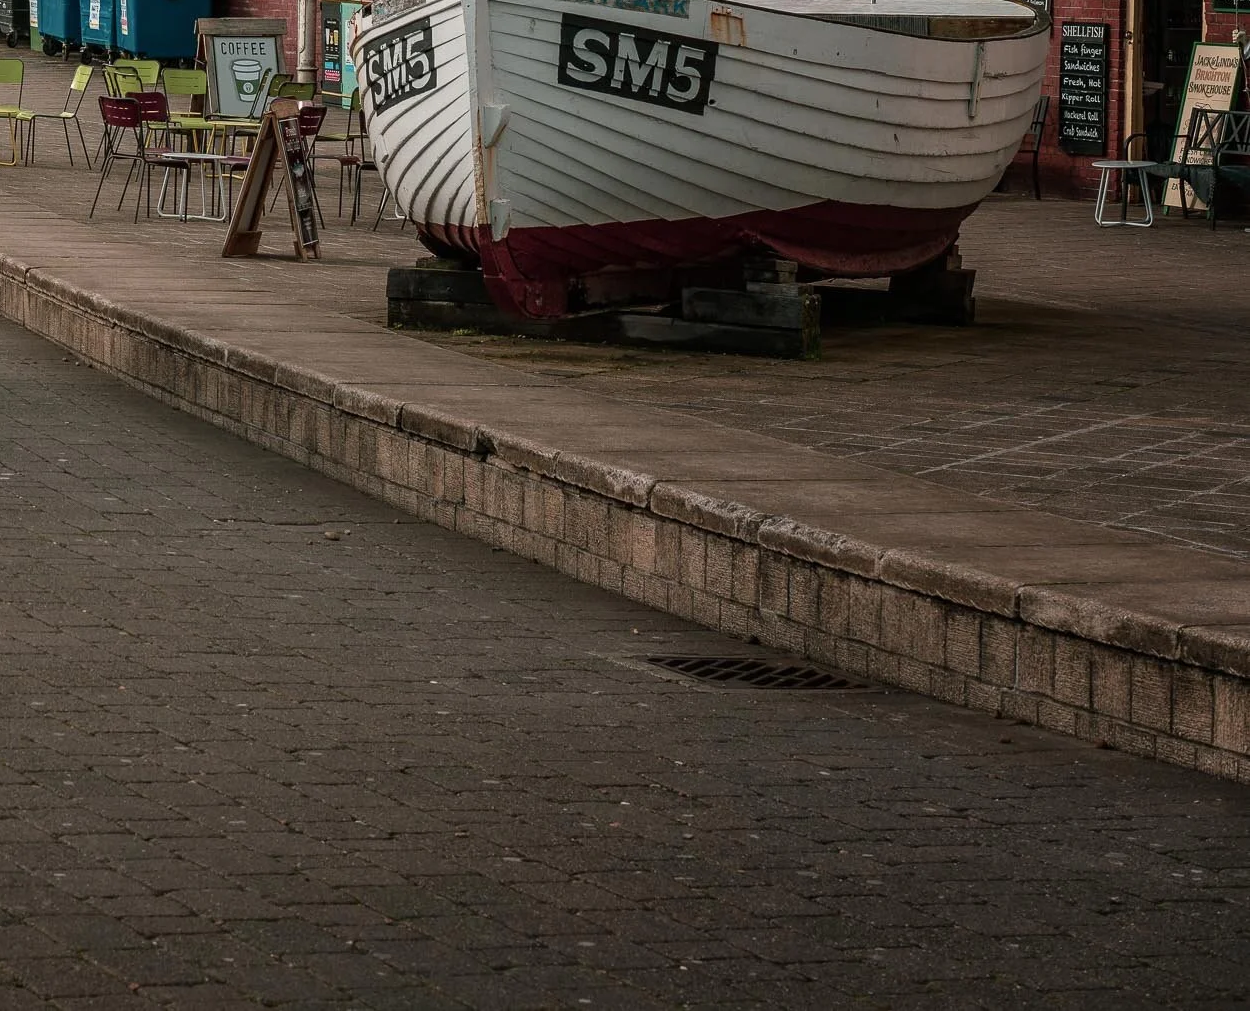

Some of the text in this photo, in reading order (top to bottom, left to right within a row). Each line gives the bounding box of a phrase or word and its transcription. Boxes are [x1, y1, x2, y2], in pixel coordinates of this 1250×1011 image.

[1062, 25, 1104, 38] SHELLFISH
[220, 42, 267, 55] COFFEE
[1063, 44, 1103, 58] Fish finger
[366, 29, 431, 106] SM5
[566, 27, 707, 103] SM5
[1064, 60, 1100, 72] Sandwiches
[1194, 69, 1232, 83] BRIGHTON
[1088, 78, 1102, 88] Hot
[1188, 82, 1232, 98] SMOKEHOUSE
[1061, 93, 1101, 105] Kipper Roll
